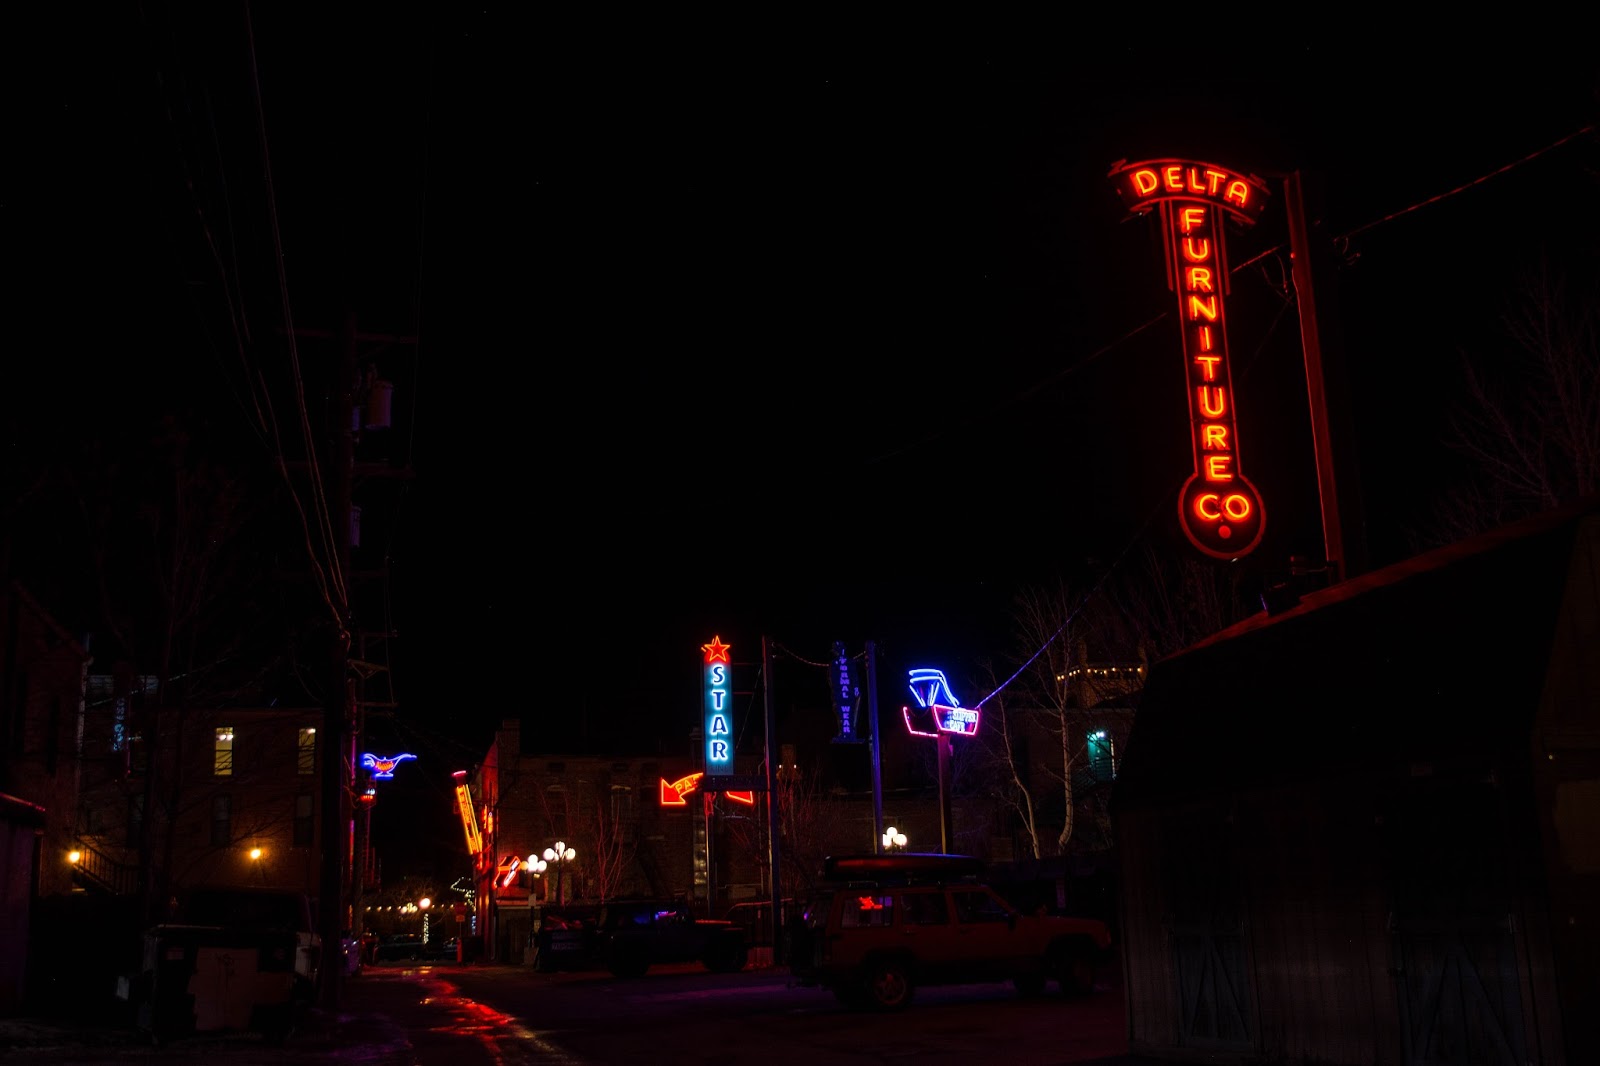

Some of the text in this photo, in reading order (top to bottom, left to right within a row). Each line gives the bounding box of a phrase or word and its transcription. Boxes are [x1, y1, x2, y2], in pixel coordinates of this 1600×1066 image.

[1130, 166, 1251, 206] DELTA
[1180, 207, 1233, 482] FURNITURE
[1194, 493, 1252, 523] CO
[710, 664, 730, 762] STAR
[841, 705, 851, 733] WEAR
